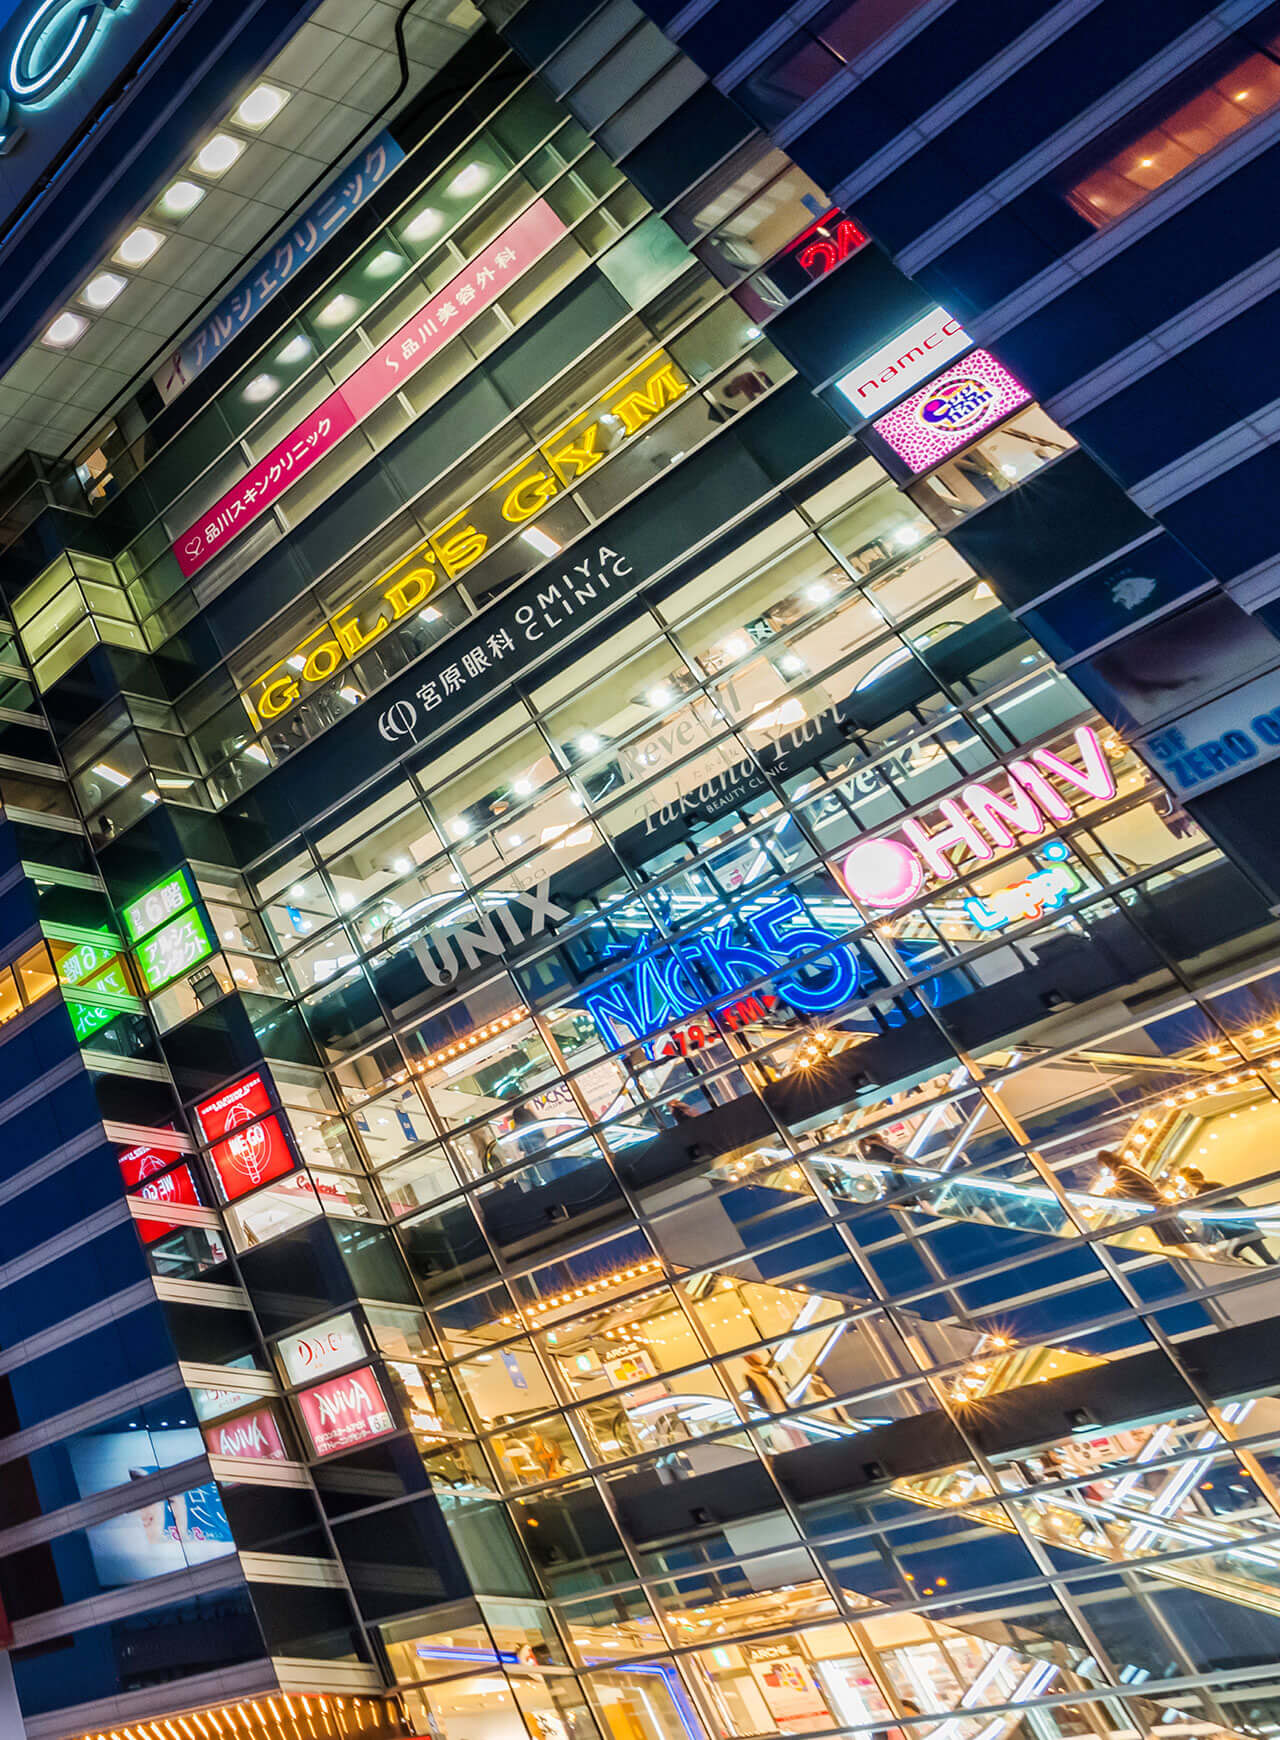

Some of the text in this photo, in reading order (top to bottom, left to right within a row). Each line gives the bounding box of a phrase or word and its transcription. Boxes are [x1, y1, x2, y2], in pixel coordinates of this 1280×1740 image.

[192, 144, 387, 366] アルシェクリニック
[401, 246, 517, 361] 品川美容外科
[204, 418, 331, 544] 品川スキンクリニック
[258, 361, 690, 719] GOLD'S GYM
[515, 545, 618, 625] OMIYA
[525, 556, 633, 641] CLINIC
[416, 628, 516, 712] 宮原眼科
[634, 758, 756, 837] Takano
[705, 784, 747, 815] BEAUTY
[748, 761, 789, 790] CLINIC
[901, 726, 1116, 881] HMV
[1165, 729, 1259, 789] ZERO
[410, 876, 571, 987] UNIX
[586, 894, 861, 1051] NACK5
